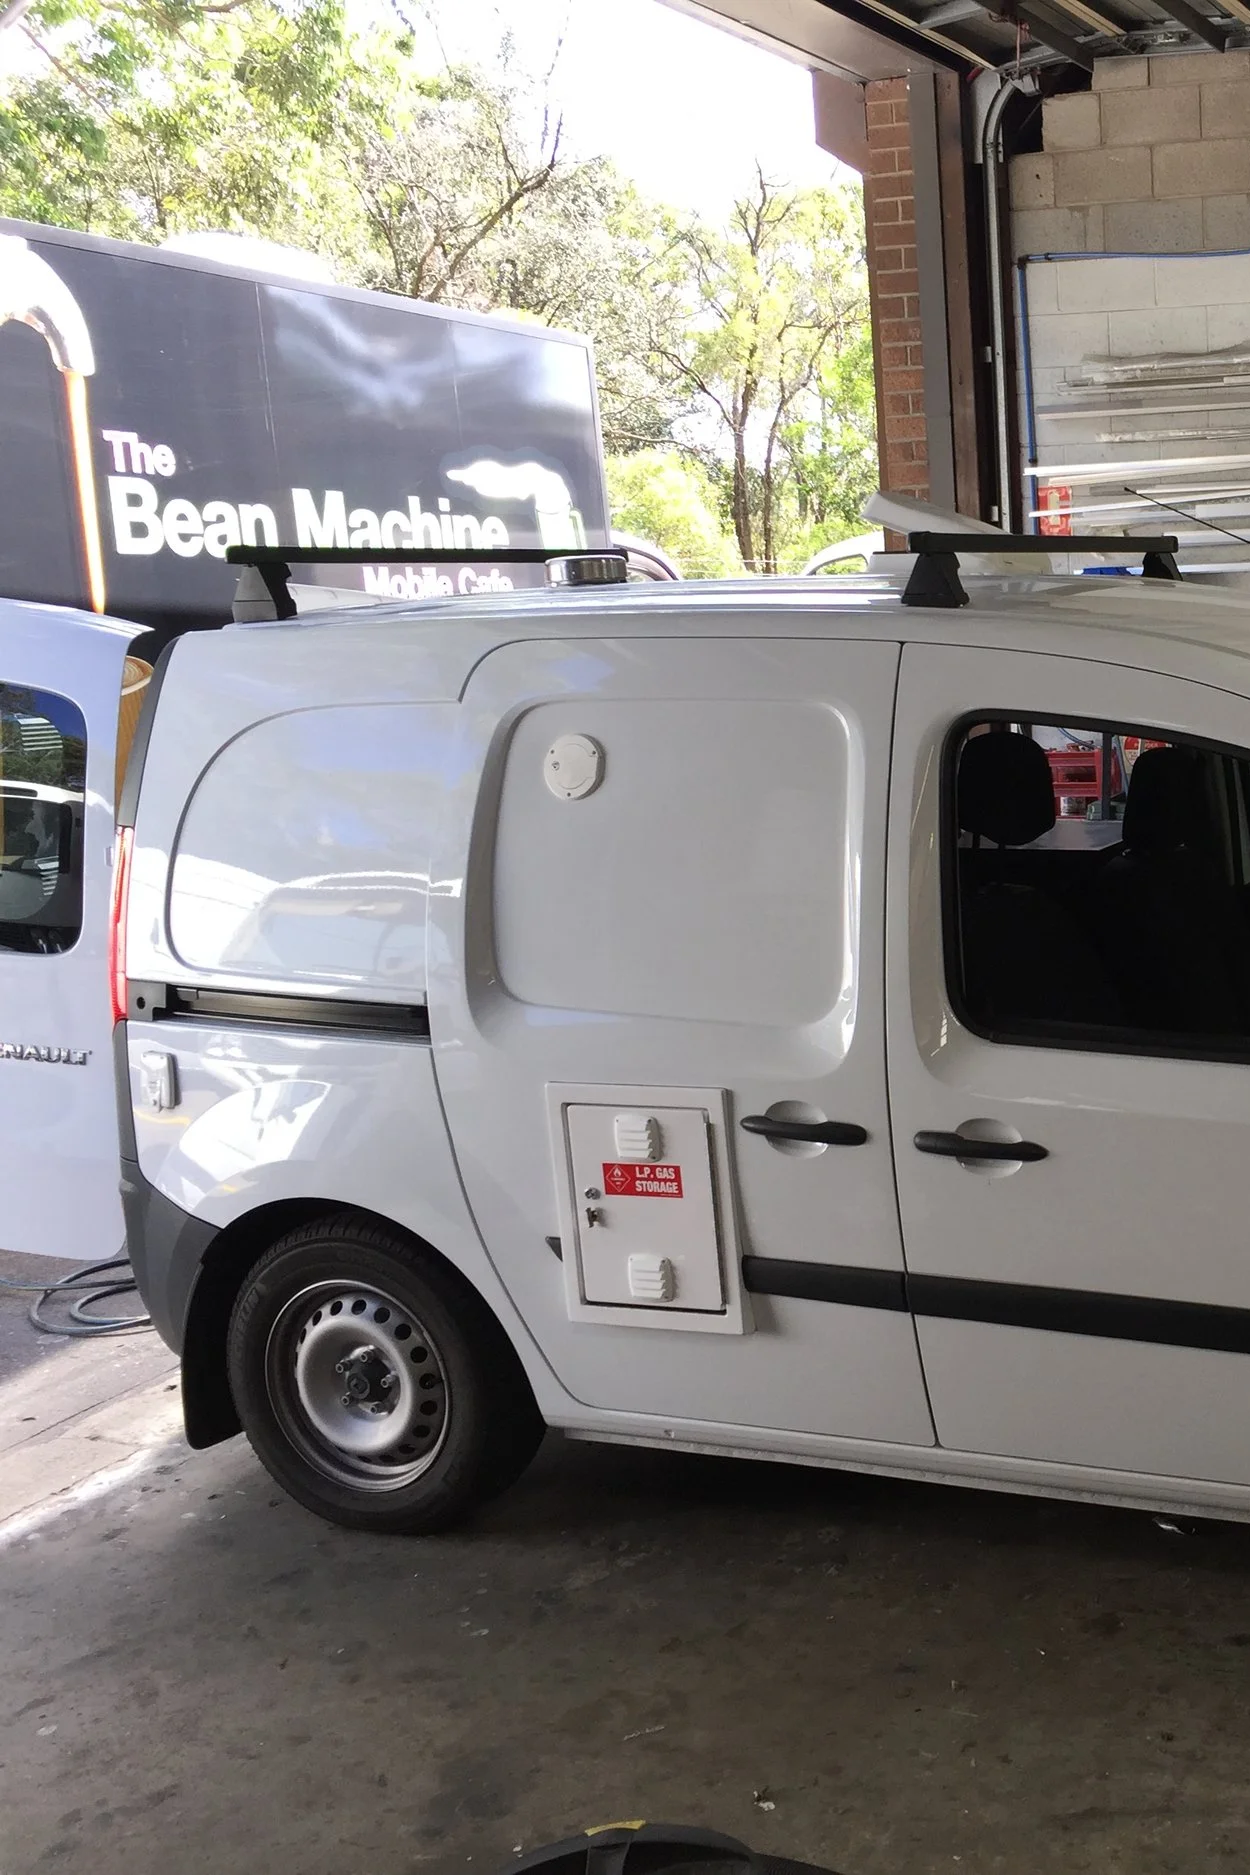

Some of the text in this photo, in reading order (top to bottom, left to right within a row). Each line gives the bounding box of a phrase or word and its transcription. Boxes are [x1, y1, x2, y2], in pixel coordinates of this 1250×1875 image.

[102, 430, 176, 477] The
[108, 475, 510, 558] Bean Machine
[363, 566, 453, 600] Mobile
[635, 1180, 679, 1193] STORAGE
[656, 1167, 675, 1179] GAS
